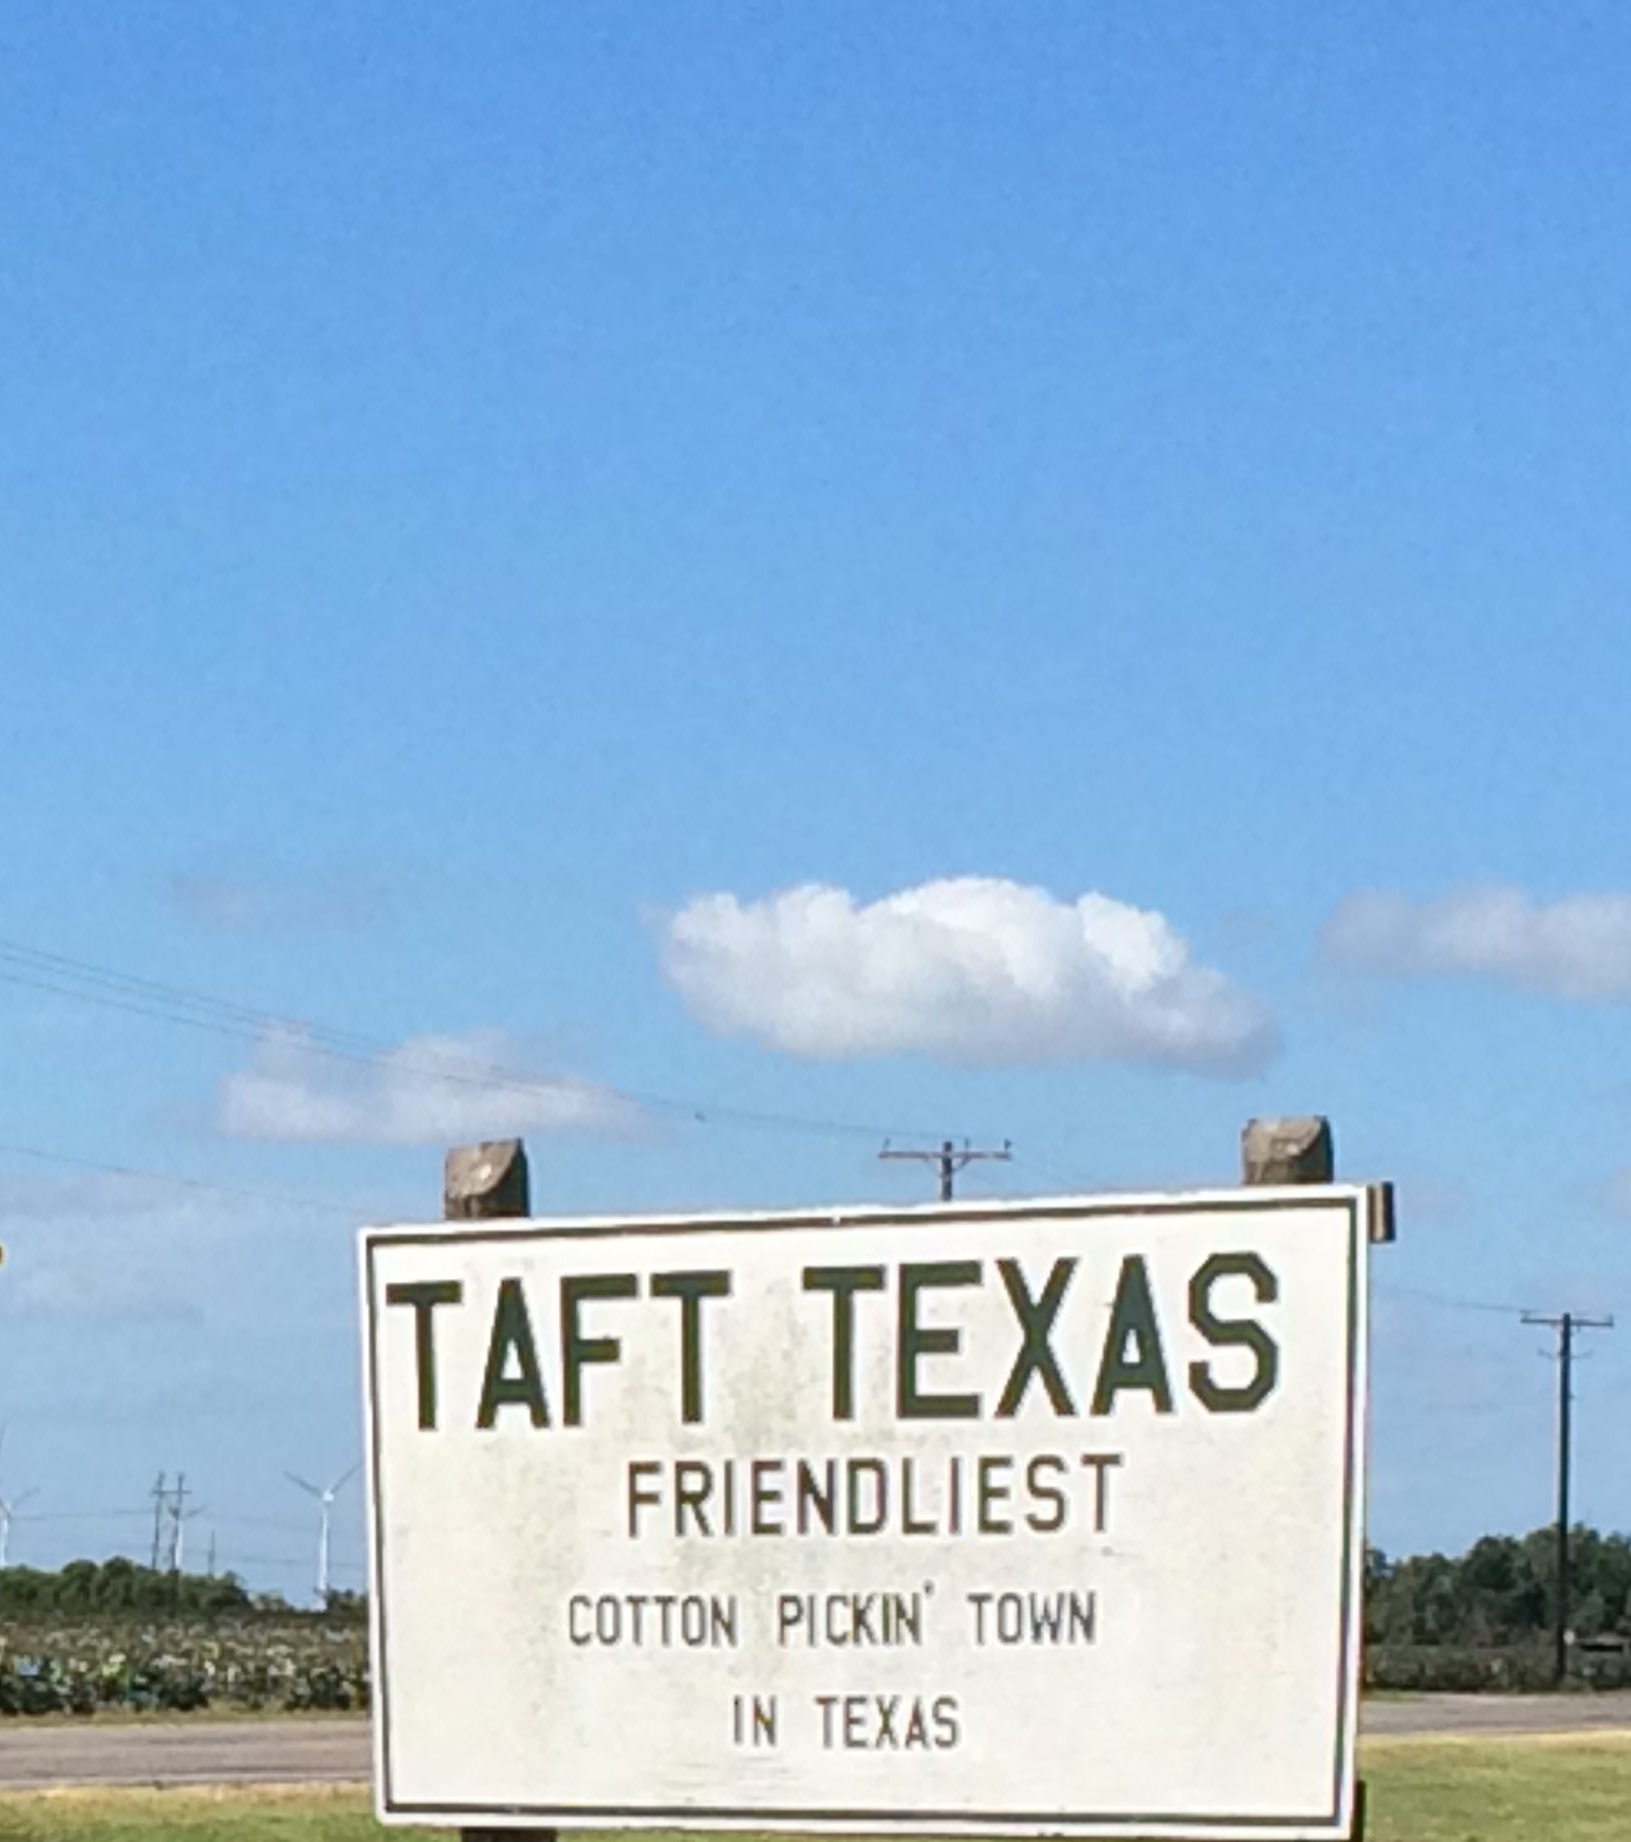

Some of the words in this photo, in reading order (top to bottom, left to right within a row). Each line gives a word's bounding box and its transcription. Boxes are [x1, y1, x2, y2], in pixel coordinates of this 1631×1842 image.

[385, 1270, 731, 1430] TAFT
[802, 1252, 1278, 1420] TEXAS
[628, 1453, 1121, 1538] FRIENDLIEST
[569, 1595, 736, 1647] COTTON
[778, 1581, 935, 1646] PICKIN'
[967, 1592, 1095, 1644] TOWN
[733, 1696, 776, 1745] IN
[815, 1695, 957, 1748] TEXAS
